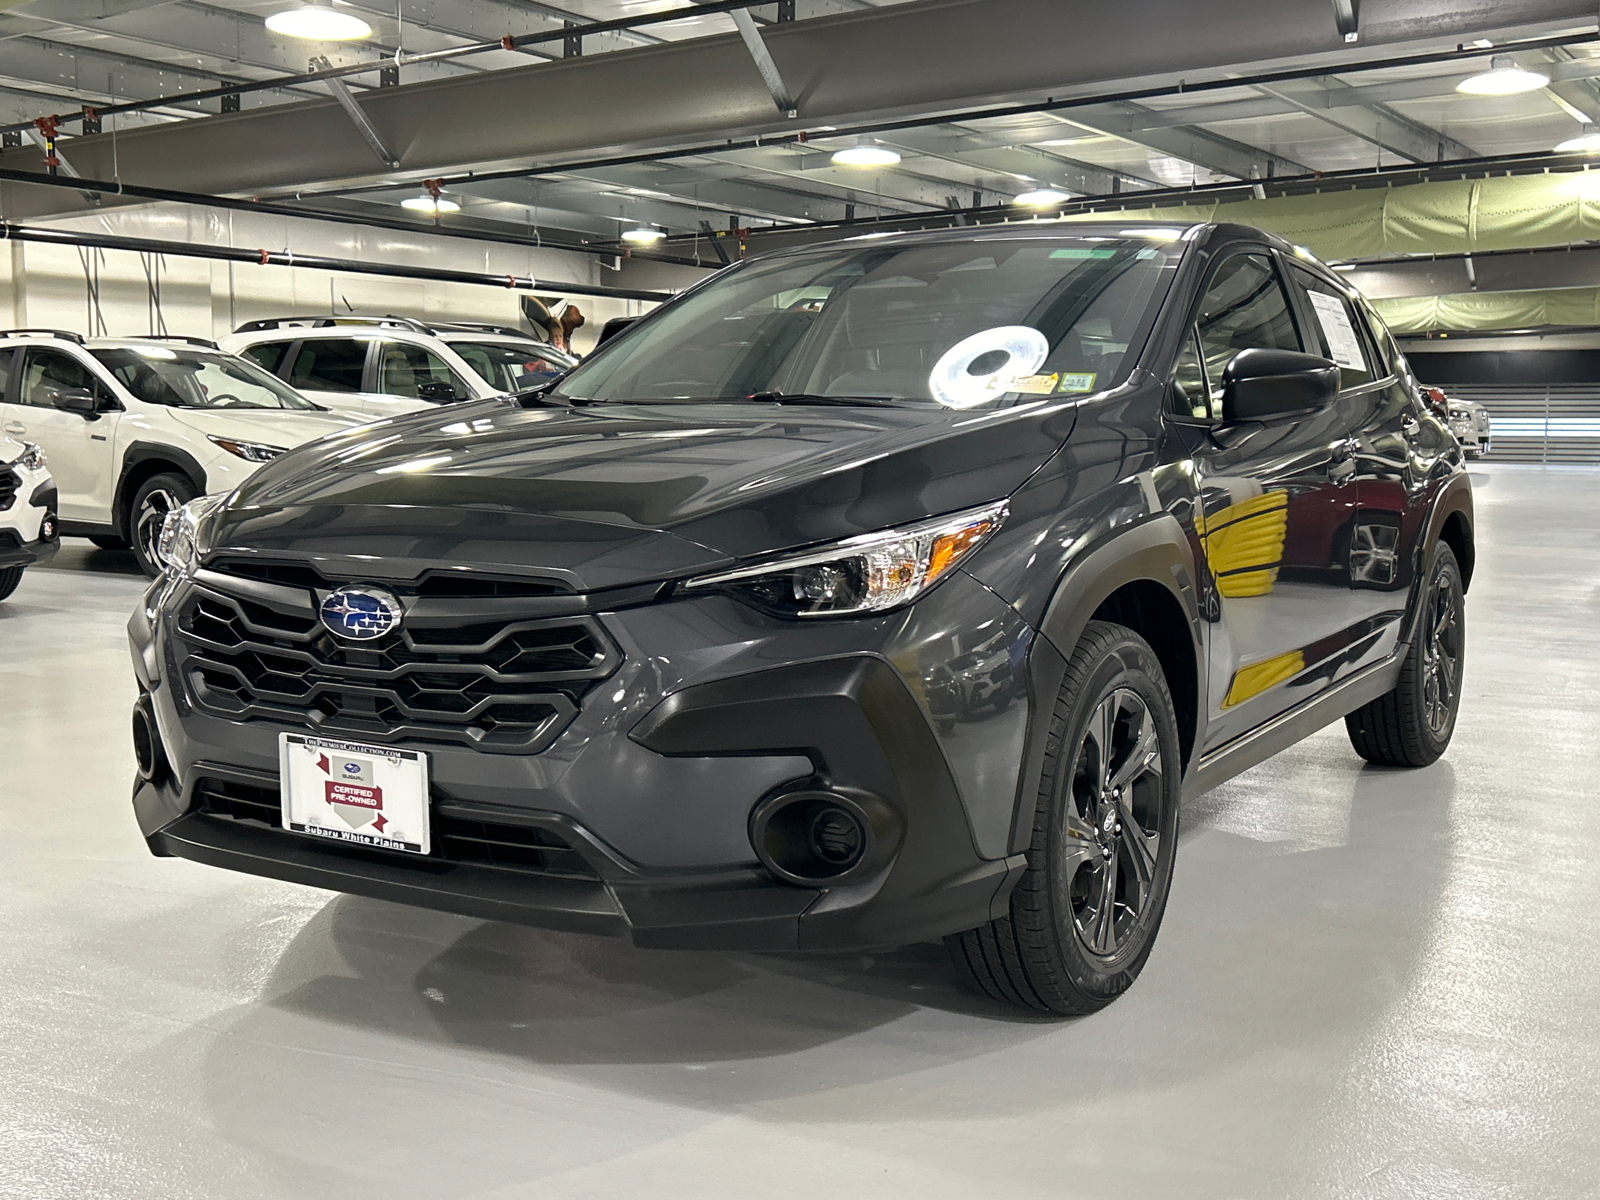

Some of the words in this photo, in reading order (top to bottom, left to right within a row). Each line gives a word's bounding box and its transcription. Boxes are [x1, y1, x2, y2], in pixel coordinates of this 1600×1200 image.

[334, 785, 373, 797] CERTIFIED
[330, 793, 377, 806] PRE-OWNED
[304, 825, 339, 838] Subaru
[341, 831, 371, 844] White
[373, 838, 405, 850] Plains
